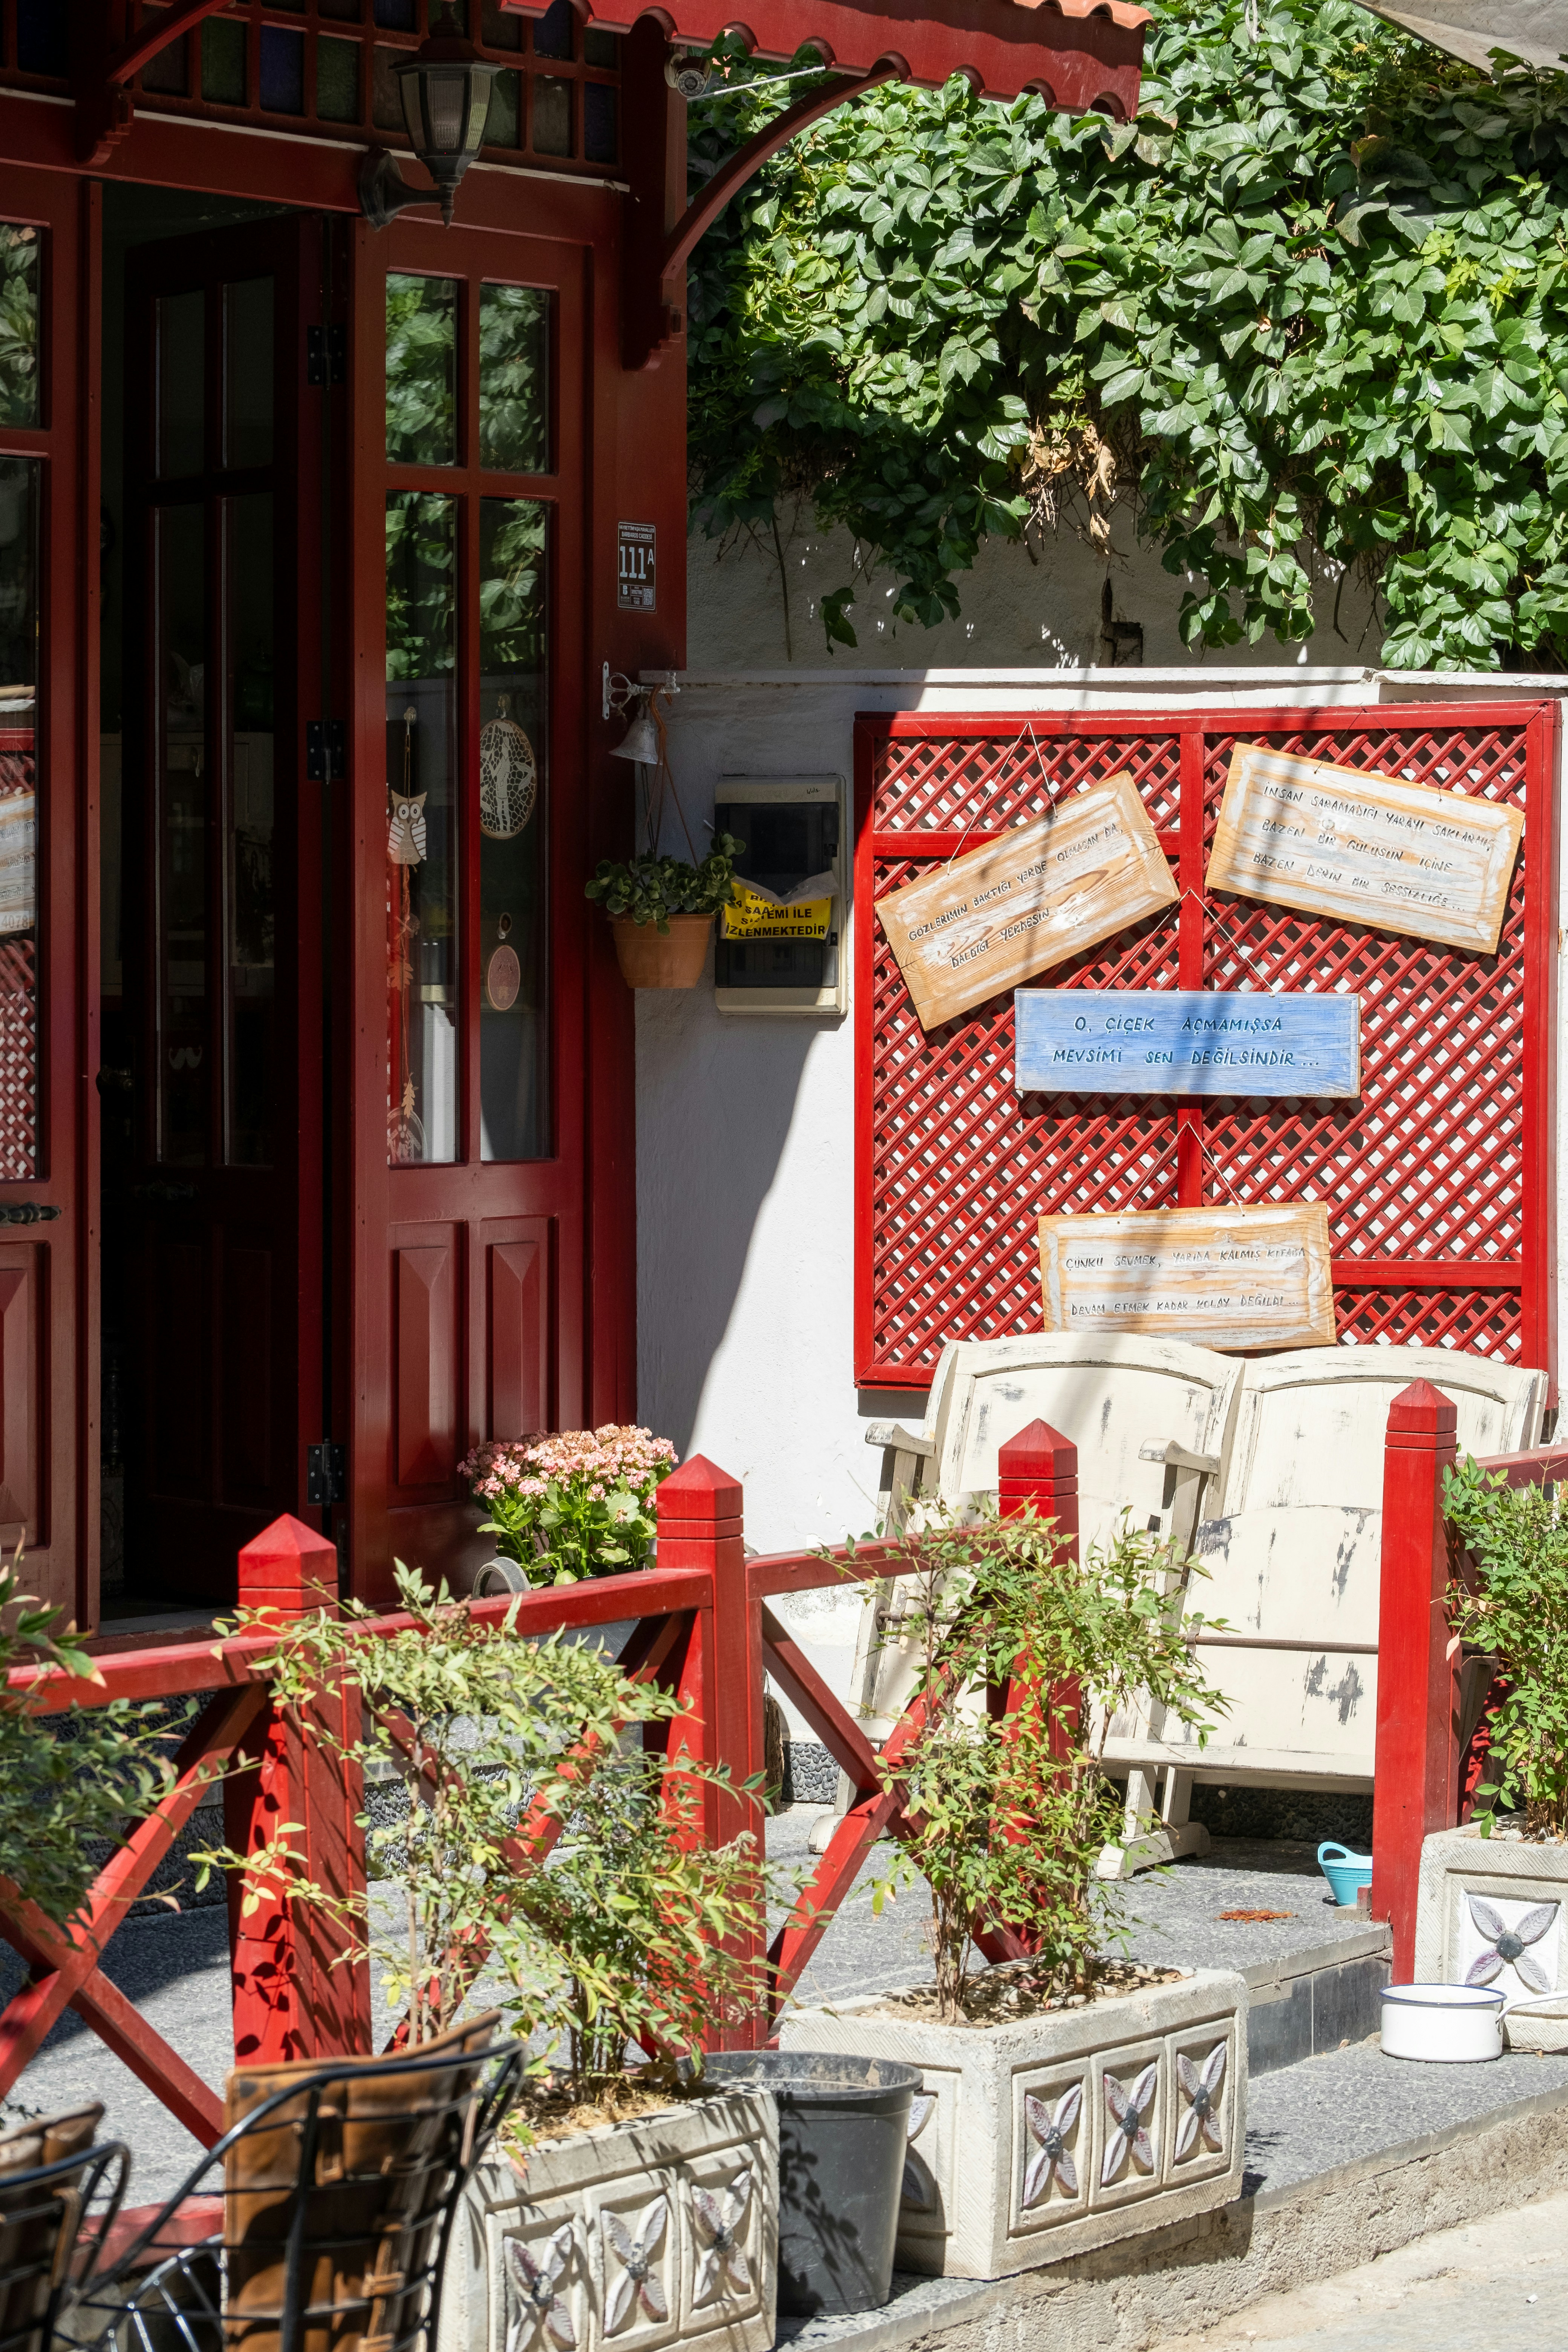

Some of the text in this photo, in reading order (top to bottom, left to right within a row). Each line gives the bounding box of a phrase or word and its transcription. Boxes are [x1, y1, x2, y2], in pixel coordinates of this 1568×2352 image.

[1262, 781, 1303, 803] İNSAN
[1309, 796, 1378, 821] SARAMADIĞI
[1386, 812, 1425, 832] YARAYI
[1260, 818, 1453, 875] BAZEN BİR GÜLÜŞÜN İÇİNE
[1251, 851, 1294, 872] BAZEN
[1305, 863, 1342, 883] DERİN
[1351, 875, 1370, 891] BİR
[908, 903, 968, 942] GÖZLERİMİN
[972, 881, 1011, 908] BAKTIĞI
[1016, 861, 1047, 885] YERDE
[1056, 833, 1099, 863] OLMASAN
[793, 906, 812, 919] İLE
[726, 922, 825, 937] İZLENMEKTEDİR
[949, 939, 989, 970] DALDIĞI
[1104, 1014, 1155, 1035] ÇİÇEK
[1180, 1016, 1283, 1035] AÇMAMIŞSA
[1051, 1046, 1122, 1064] MEVSİMİ
[1144, 1050, 1173, 1065] SEN
[1066, 1254, 1104, 1271] ÇÜNKÜ
[1112, 1255, 1161, 1268] SEVMEK,
[1171, 1251, 1210, 1265] YARIDA
[1218, 1249, 1261, 1262] KALMIŞ
[1070, 1303, 1106, 1317] DEVAM
[1113, 1302, 1150, 1315] ETMEK
[1156, 1300, 1188, 1312] KADAR
[1195, 1297, 1230, 1311] KOLAY
